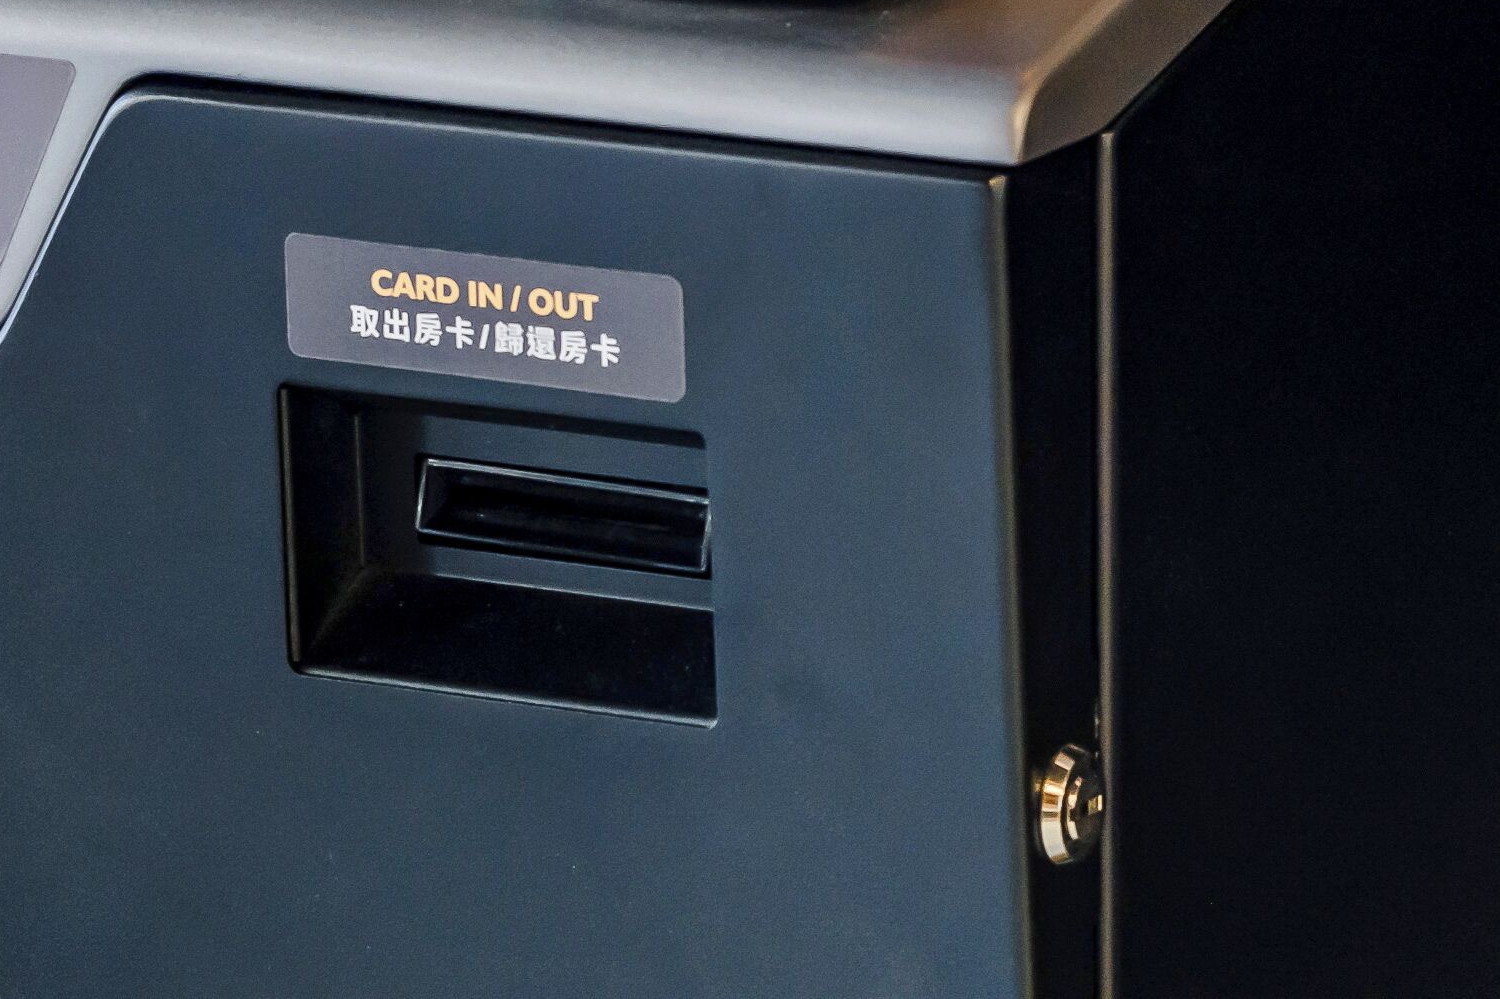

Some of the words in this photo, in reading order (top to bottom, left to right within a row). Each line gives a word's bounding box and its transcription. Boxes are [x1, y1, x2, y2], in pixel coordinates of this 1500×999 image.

[370, 268, 460, 306] CARD
[467, 280, 504, 311] IN
[510, 285, 522, 313] /
[527, 287, 600, 322] OUT
[349, 304, 621, 368] 取出房卡/歸還房卡
